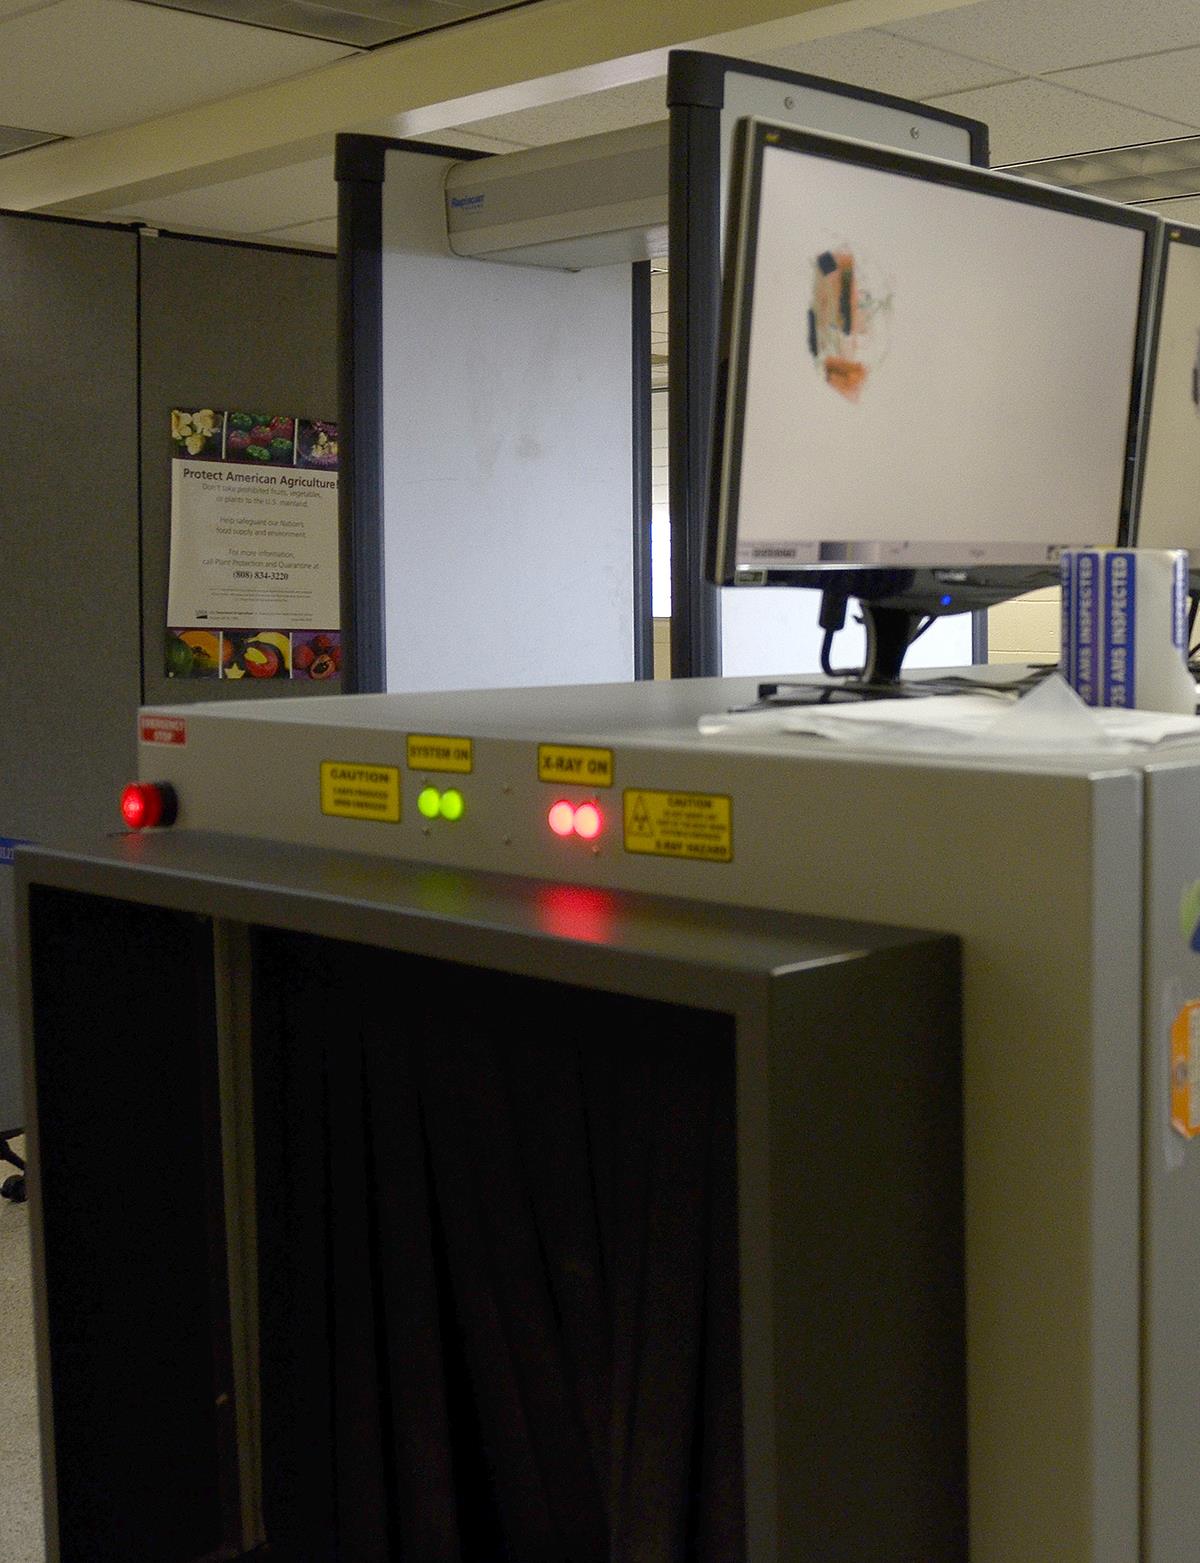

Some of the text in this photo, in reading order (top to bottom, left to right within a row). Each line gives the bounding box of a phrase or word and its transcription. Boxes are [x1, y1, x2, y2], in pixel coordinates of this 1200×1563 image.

[183, 468, 223, 481] Protect
[226, 471, 277, 485] American
[233, 571, 289, 581] (808) 834-3220
[1079, 556, 1093, 645] INSPECTED
[1111, 556, 1127, 645] INSPECTED
[410, 745, 469, 761] SYSTEM ON
[542, 756, 608, 774] X-RAY ON
[329, 768, 390, 784] CAUTION
